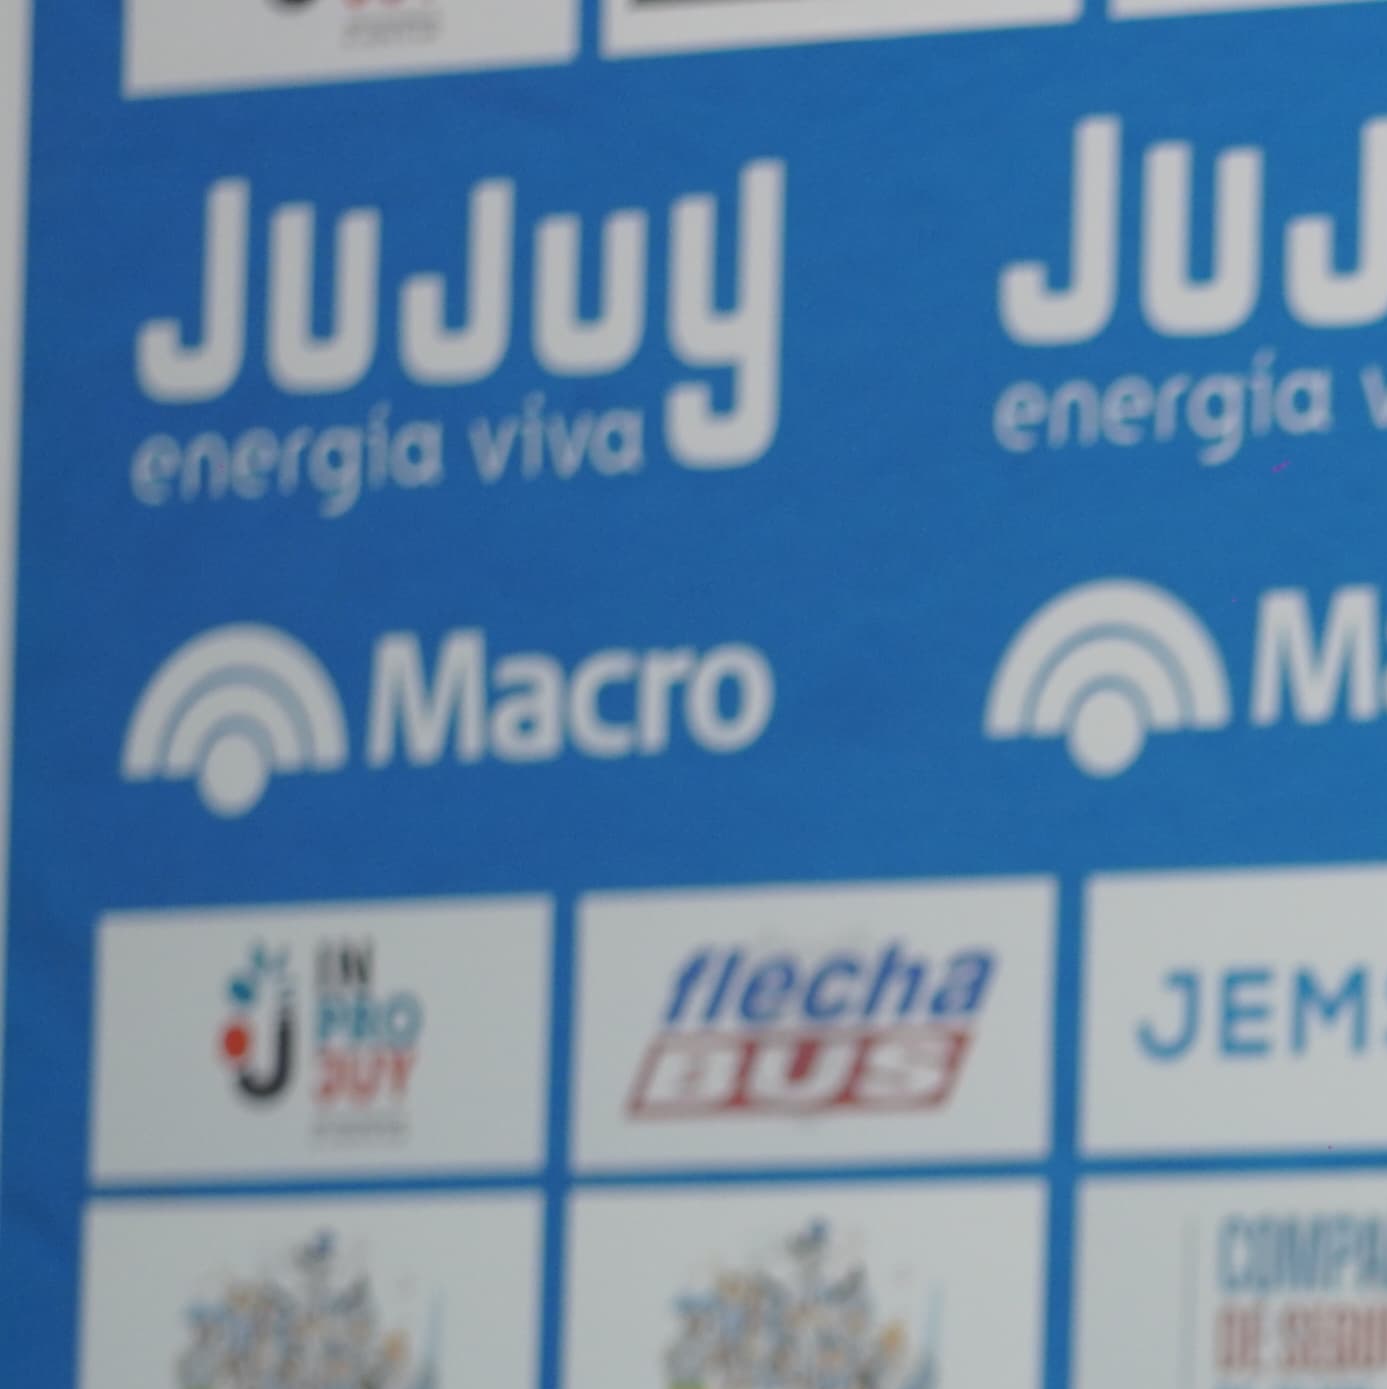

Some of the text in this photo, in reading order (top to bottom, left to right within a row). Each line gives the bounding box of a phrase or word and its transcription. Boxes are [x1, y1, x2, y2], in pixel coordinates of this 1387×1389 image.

[131, 393, 645, 517] energía viva
[994, 349, 1332, 466] energía
[367, 627, 776, 769] Macro
[314, 938, 376, 991] IN
[662, 938, 1000, 1024] flecha
[315, 996, 423, 1047] PRO
